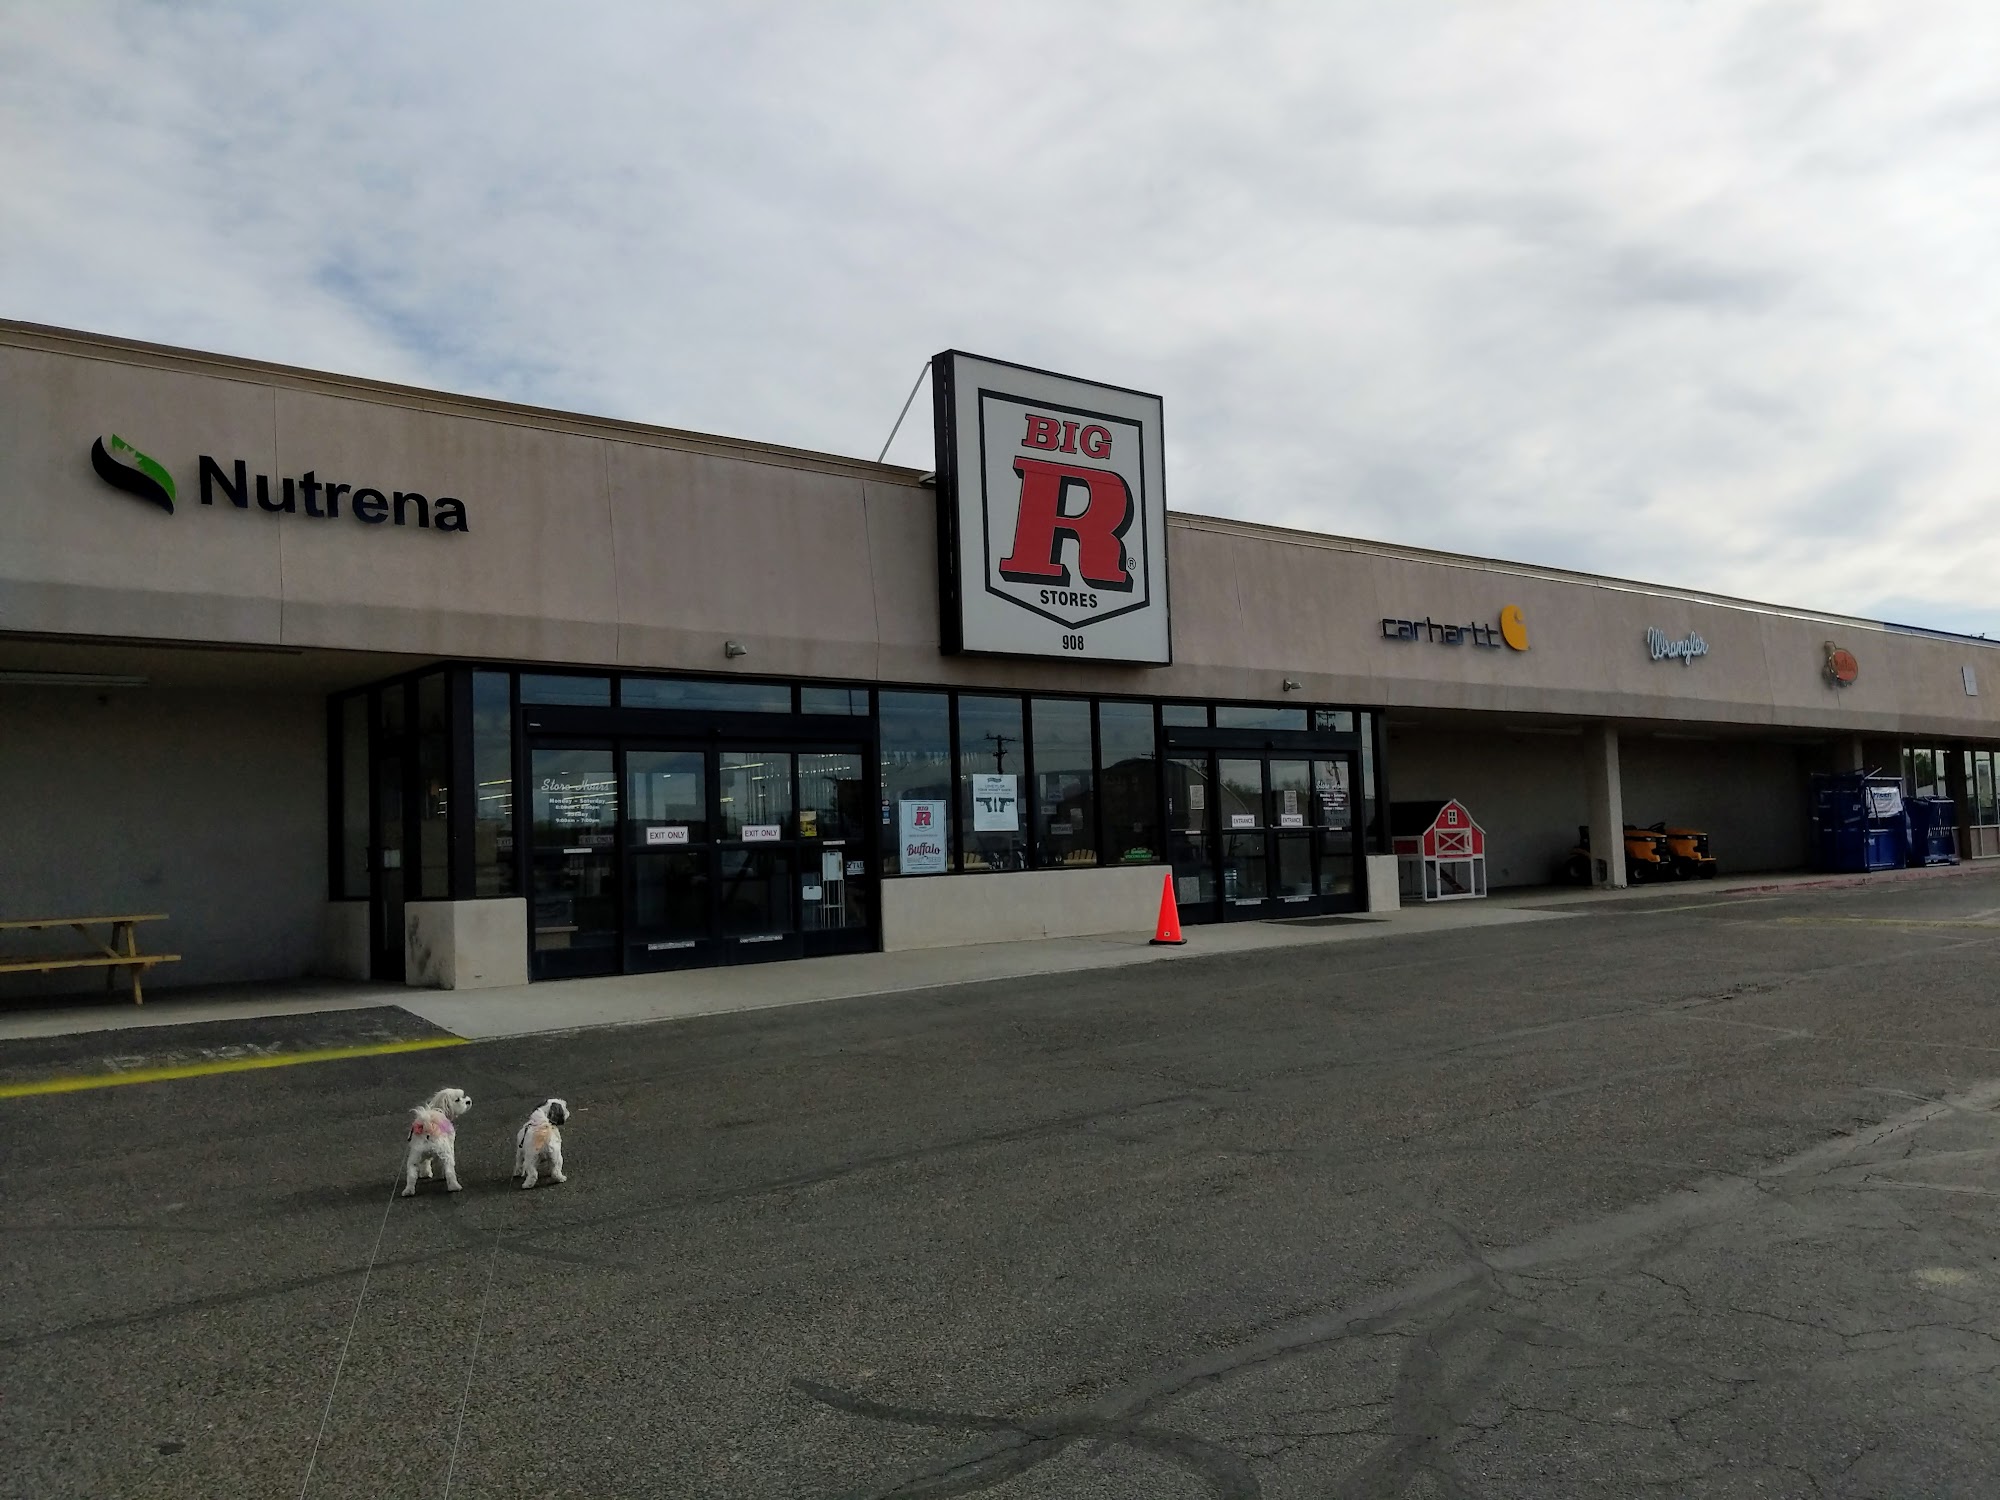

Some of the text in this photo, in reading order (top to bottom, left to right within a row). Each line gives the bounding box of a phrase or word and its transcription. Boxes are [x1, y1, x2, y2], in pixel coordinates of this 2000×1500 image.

[1021, 413, 1113, 460] BIG
[198, 455, 470, 533] Nutrena
[998, 455, 1135, 593] R
[1040, 589, 1098, 609] STORES
[1381, 616, 1501, 649] carhartt
[1062, 634, 1085, 651] 908
[1647, 626, 1709, 666] Wrangler
[541, 778, 609, 791] Store Hours
[914, 811, 931, 826] R
[649, 831, 685, 840] EXIT ONLY
[744, 829, 778, 837] EXIT ONLY
[907, 842, 941, 856] Buffalo
